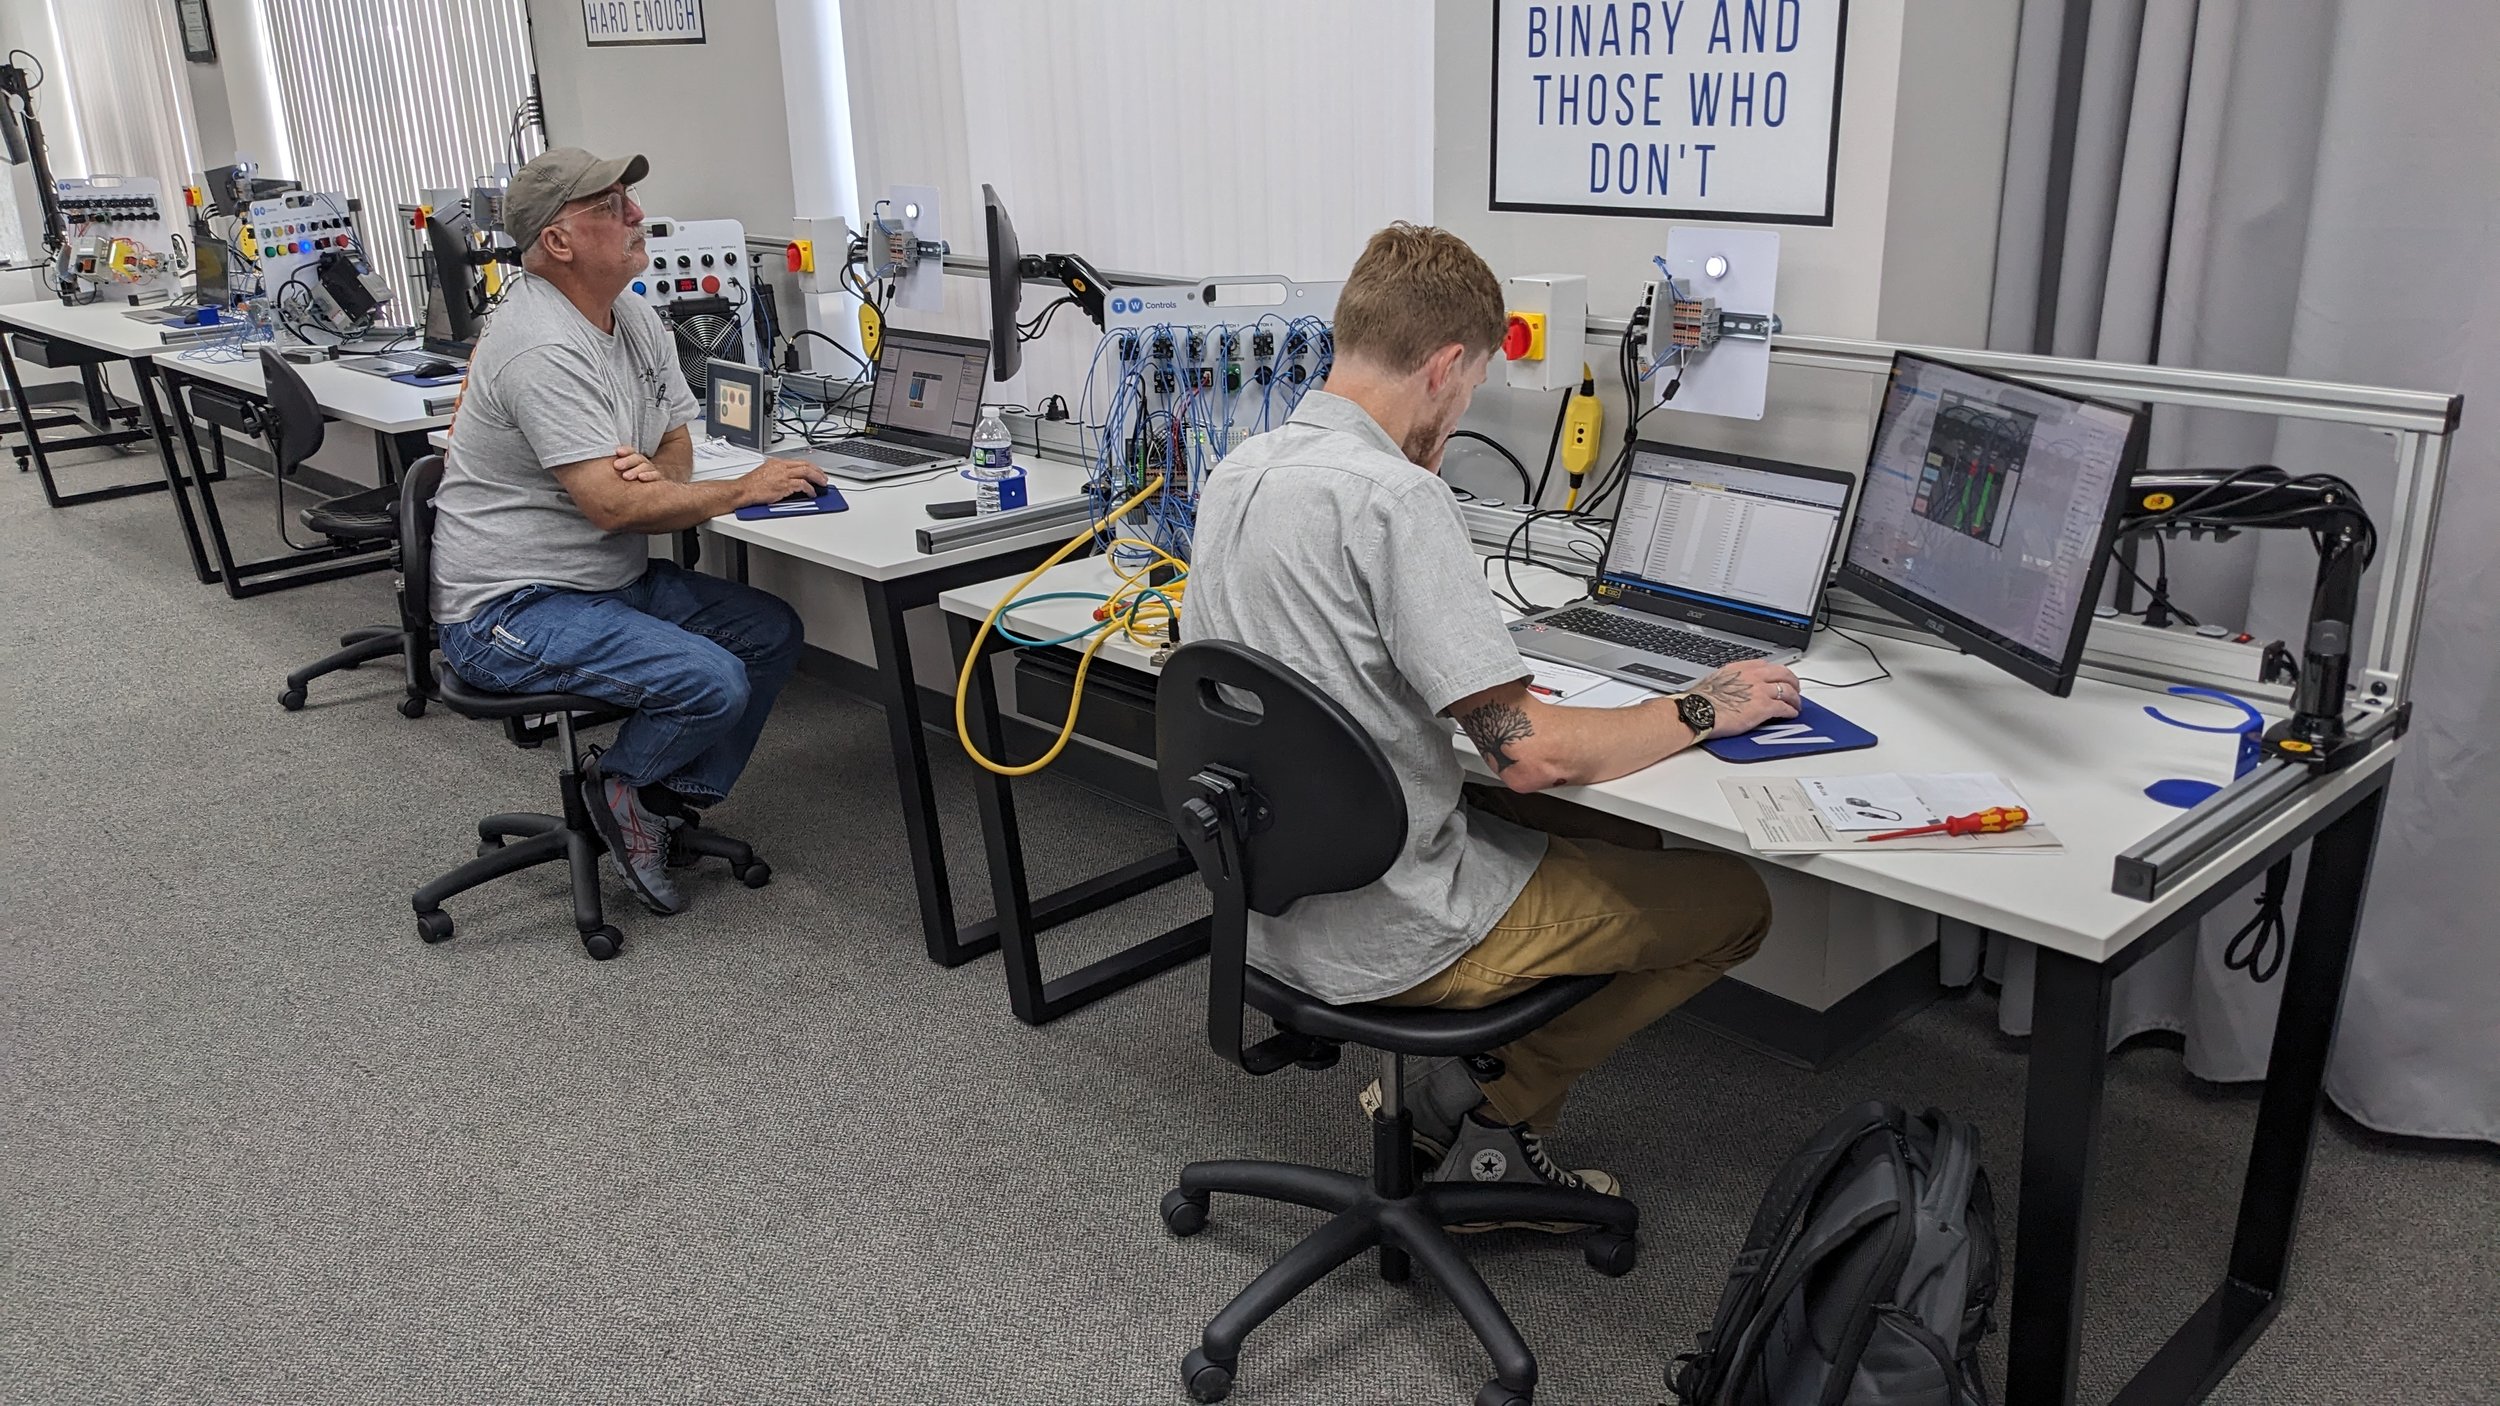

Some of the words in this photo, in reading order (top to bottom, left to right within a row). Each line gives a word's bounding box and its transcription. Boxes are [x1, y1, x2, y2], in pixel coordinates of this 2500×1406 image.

[588, 1, 628, 34] HARD
[633, 0, 697, 32] ENOUGH
[1527, 0, 1685, 58] BINARY
[1707, 0, 1801, 54] AND
[1532, 73, 1664, 126] THOSE
[1689, 71, 1788, 128] WHO
[1589, 142, 1716, 197] DON'T
[1145, 301, 1177, 309] Controls
[1686, 610, 1706, 619] acer
[1925, 618, 1945, 634] ASUS
